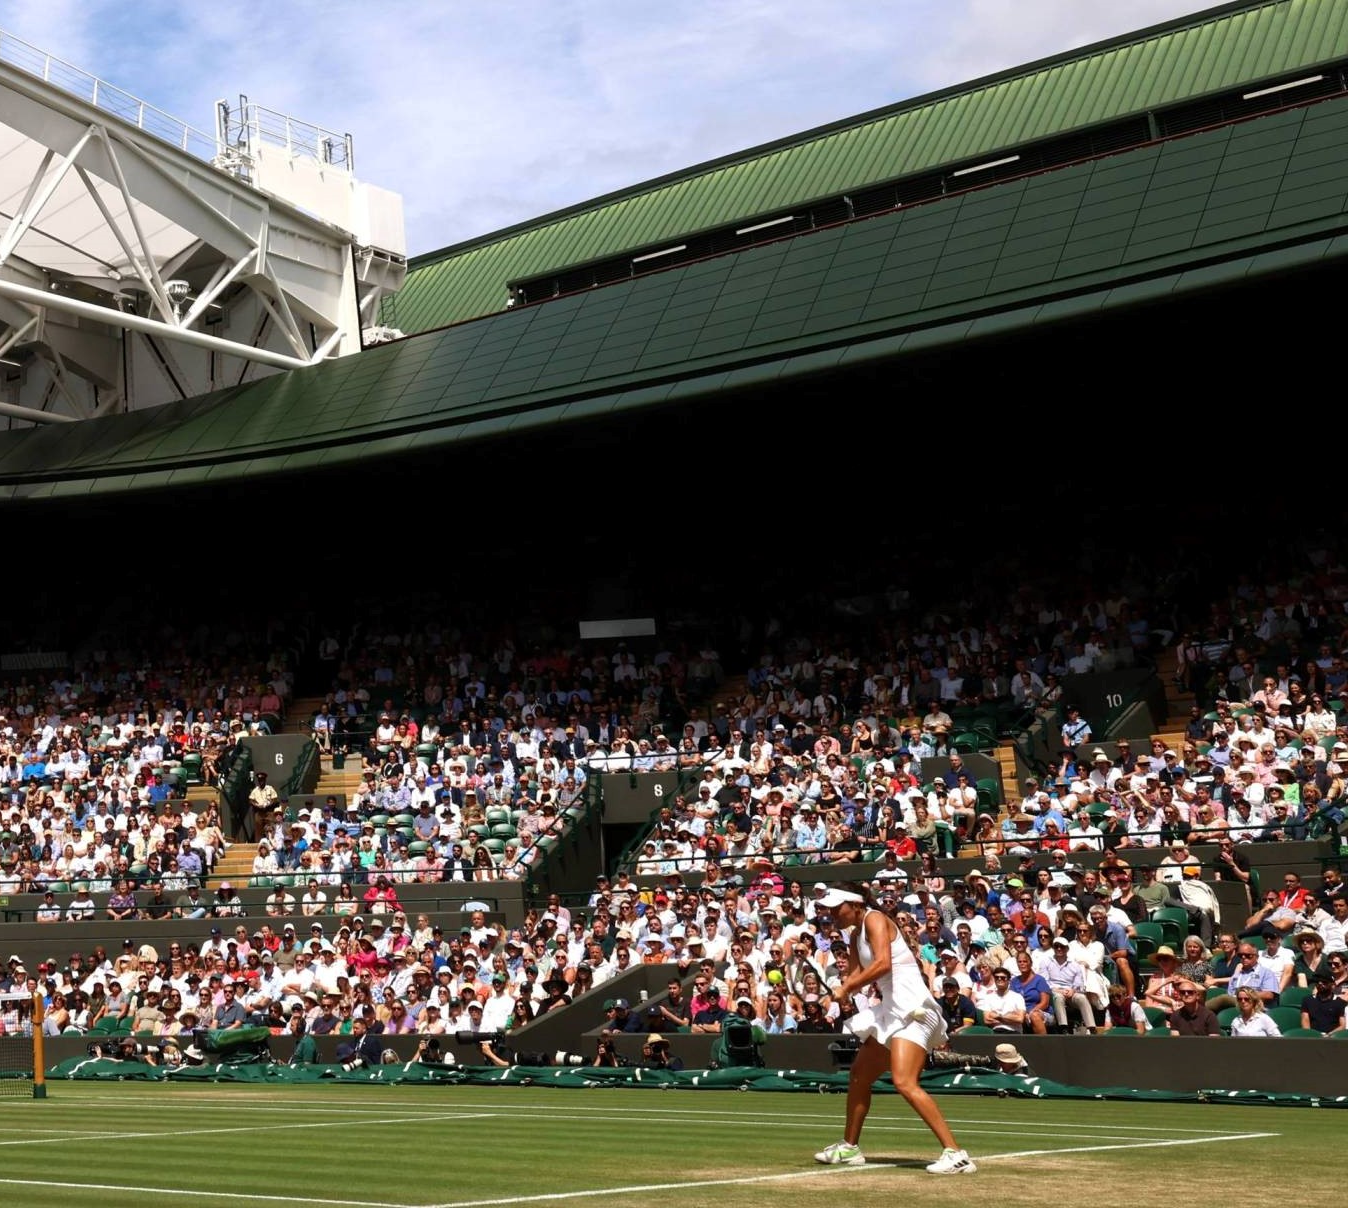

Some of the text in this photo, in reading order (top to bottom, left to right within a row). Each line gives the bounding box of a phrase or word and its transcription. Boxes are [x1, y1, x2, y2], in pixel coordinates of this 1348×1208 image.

[1106, 693, 1123, 708] 10
[275, 753, 284, 766] 6
[654, 784, 663, 797] 8
